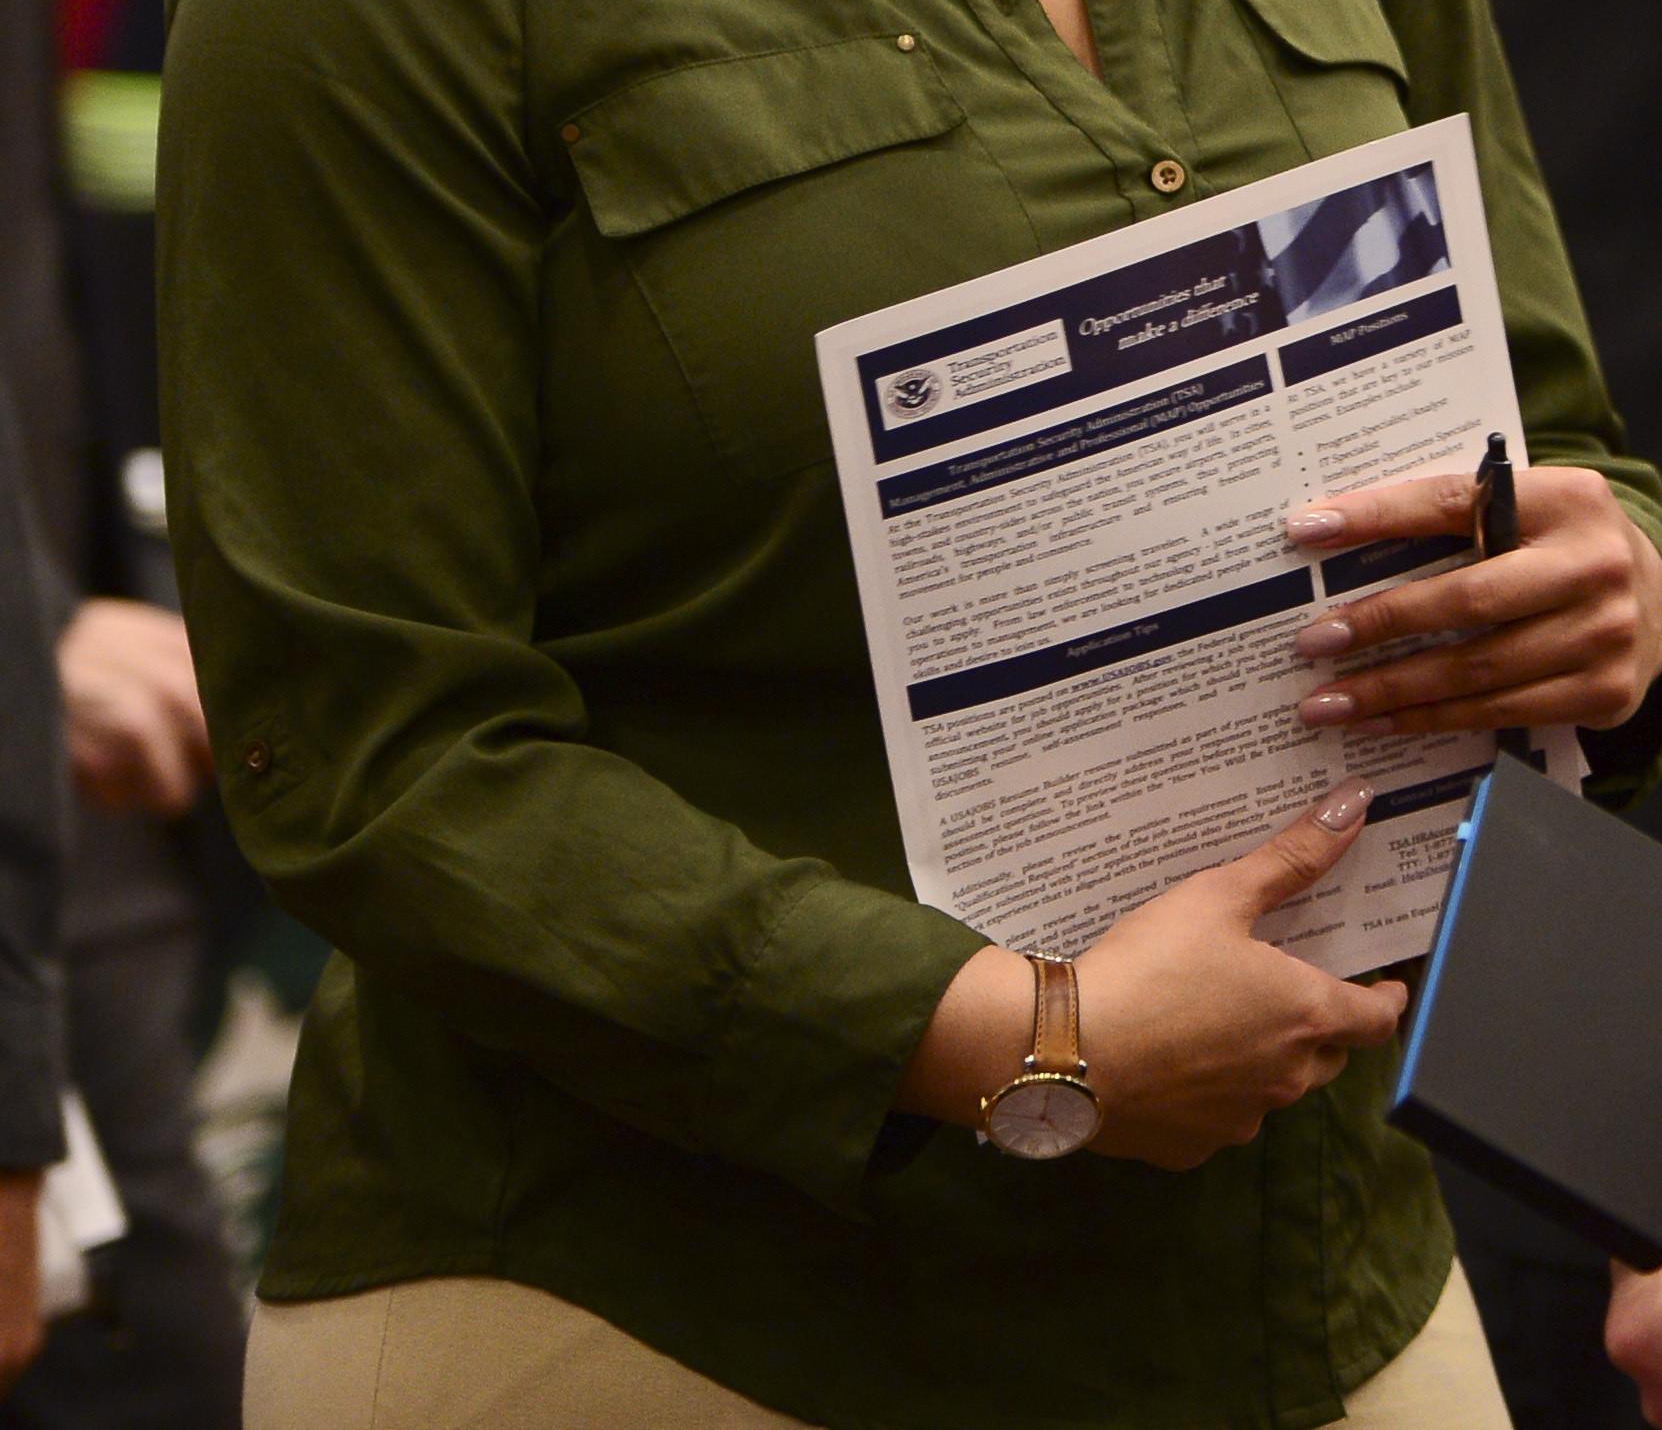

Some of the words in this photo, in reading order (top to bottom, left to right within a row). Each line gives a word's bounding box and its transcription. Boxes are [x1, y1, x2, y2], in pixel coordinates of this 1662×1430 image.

[1078, 288, 1192, 336] Opportunities
[1193, 275, 1227, 297] that
[1117, 322, 1167, 351] make
[1180, 292, 1260, 328] difference
[947, 331, 1059, 374] Transportation
[949, 360, 1013, 388] Security
[953, 356, 1067, 401] Administration
[1066, 631, 1132, 658] Application
[1132, 622, 1160, 636] Tips
[1021, 856, 1055, 876] please
[1061, 841, 1097, 859] review
[1128, 816, 1171, 838] position
[1178, 792, 1249, 820] requirements
[1255, 777, 1285, 796] listed
[1081, 846, 1118, 865] section
[1254, 794, 1281, 808] Your
[1282, 775, 1330, 799] USAJOBS
[995, 882, 1047, 910] submitted
[1049, 874, 1073, 889] with
[1075, 864, 1100, 882] your
[1103, 844, 1160, 870] application
[1162, 830, 1198, 849] should
[1200, 825, 1222, 838] also
[1224, 812, 1265, 830] directly
[1268, 797, 1309, 817] address
[986, 899, 1040, 927] experience
[1041, 891, 1063, 905] that
[1074, 871, 1112, 893] aligned
[1113, 863, 1137, 878] with
[1156, 844, 1200, 866] position
[1410, 901, 1442, 919] Equal
